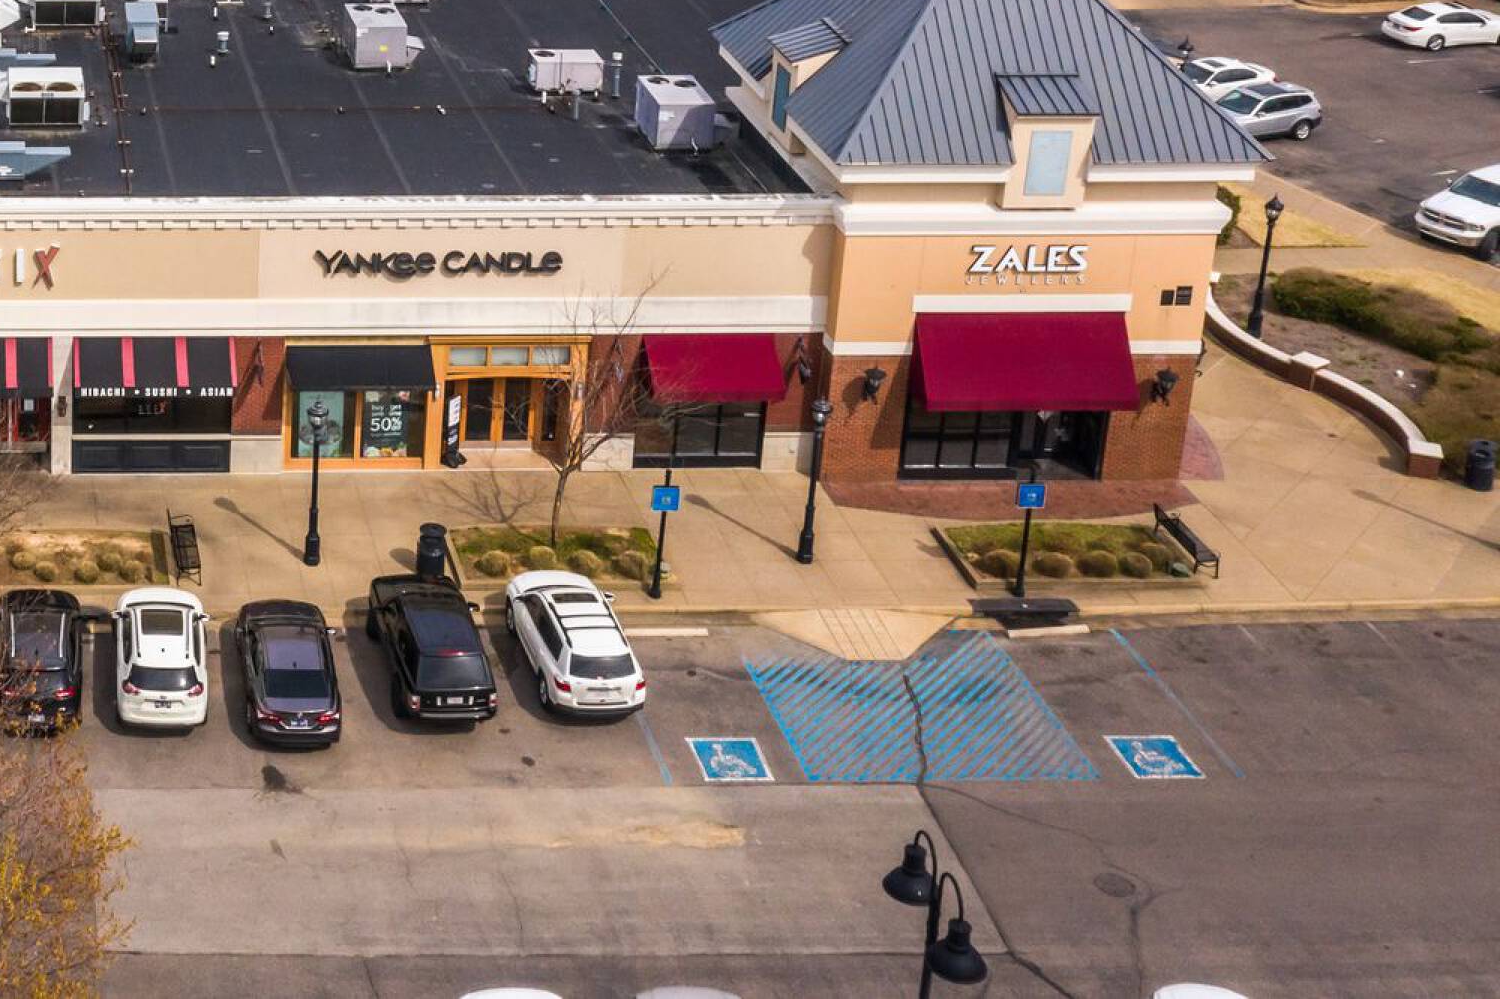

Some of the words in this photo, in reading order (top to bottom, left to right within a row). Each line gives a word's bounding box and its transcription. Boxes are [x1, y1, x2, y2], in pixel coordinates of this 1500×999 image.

[966, 244, 1090, 273] ZALES
[80, 387, 126, 397] HIBACHI
[144, 387, 178, 397] SUSHI
[200, 387, 234, 397] ASIAN
